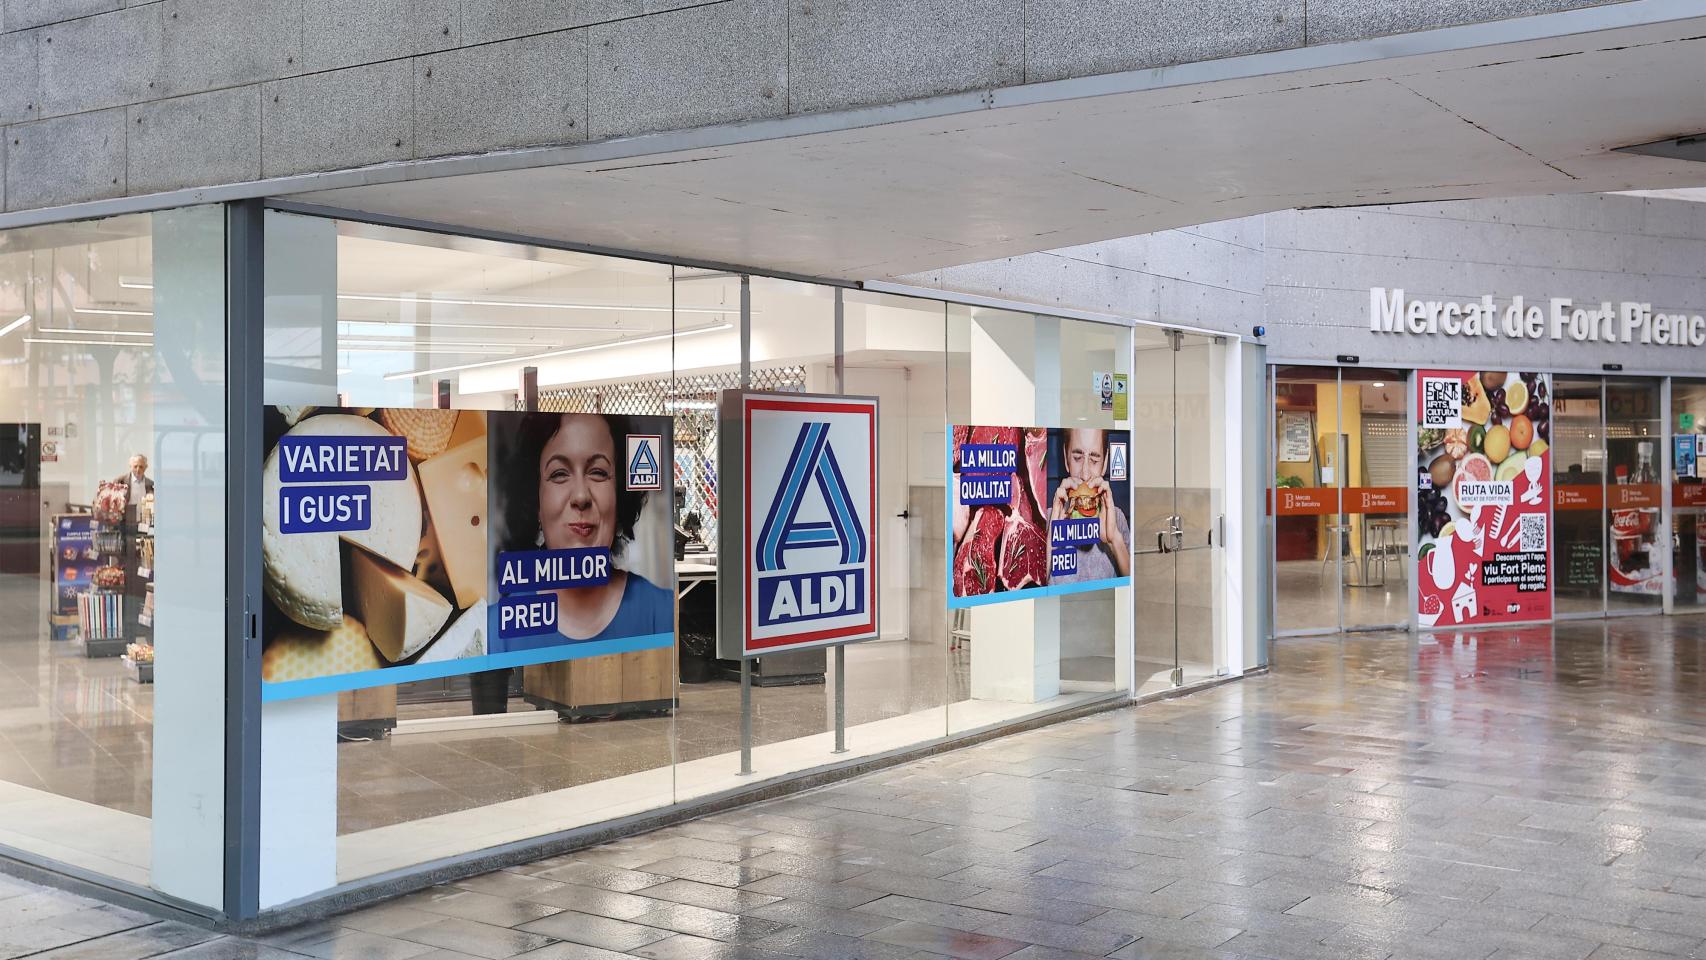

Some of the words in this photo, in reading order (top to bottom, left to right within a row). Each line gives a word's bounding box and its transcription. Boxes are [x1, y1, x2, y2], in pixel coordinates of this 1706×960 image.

[1369, 286, 1496, 337] Mercat
[1502, 295, 1544, 339] de
[1550, 298, 1616, 342] Fort
[1620, 301, 1706, 346] Pienc
[283, 445, 404, 473] VARIETAT
[961, 451, 975, 468] LA
[978, 450, 1016, 468] MILLOR
[633, 474, 656, 485] ALDI
[961, 480, 1010, 499] QUALITAT
[1461, 485, 1487, 495] RUTA
[1489, 485, 1511, 495] VIDA
[284, 496, 290, 524] I
[299, 494, 367, 523] GUST
[1052, 525, 1066, 542] AL
[1066, 523, 1099, 541] MILLOR
[1052, 552, 1076, 571] PREU
[1495, 553, 1531, 562] Descarrega't
[501, 560, 529, 586] AL
[535, 554, 607, 583] MILLOR
[1484, 563, 1498, 575] viu
[1500, 563, 1519, 575] Fort
[1521, 562, 1546, 574] Pienc
[1487, 576, 1512, 585] participa
[1527, 574, 1546, 582] sorteig
[768, 573, 856, 621] ALDI
[501, 601, 555, 630] PREU
